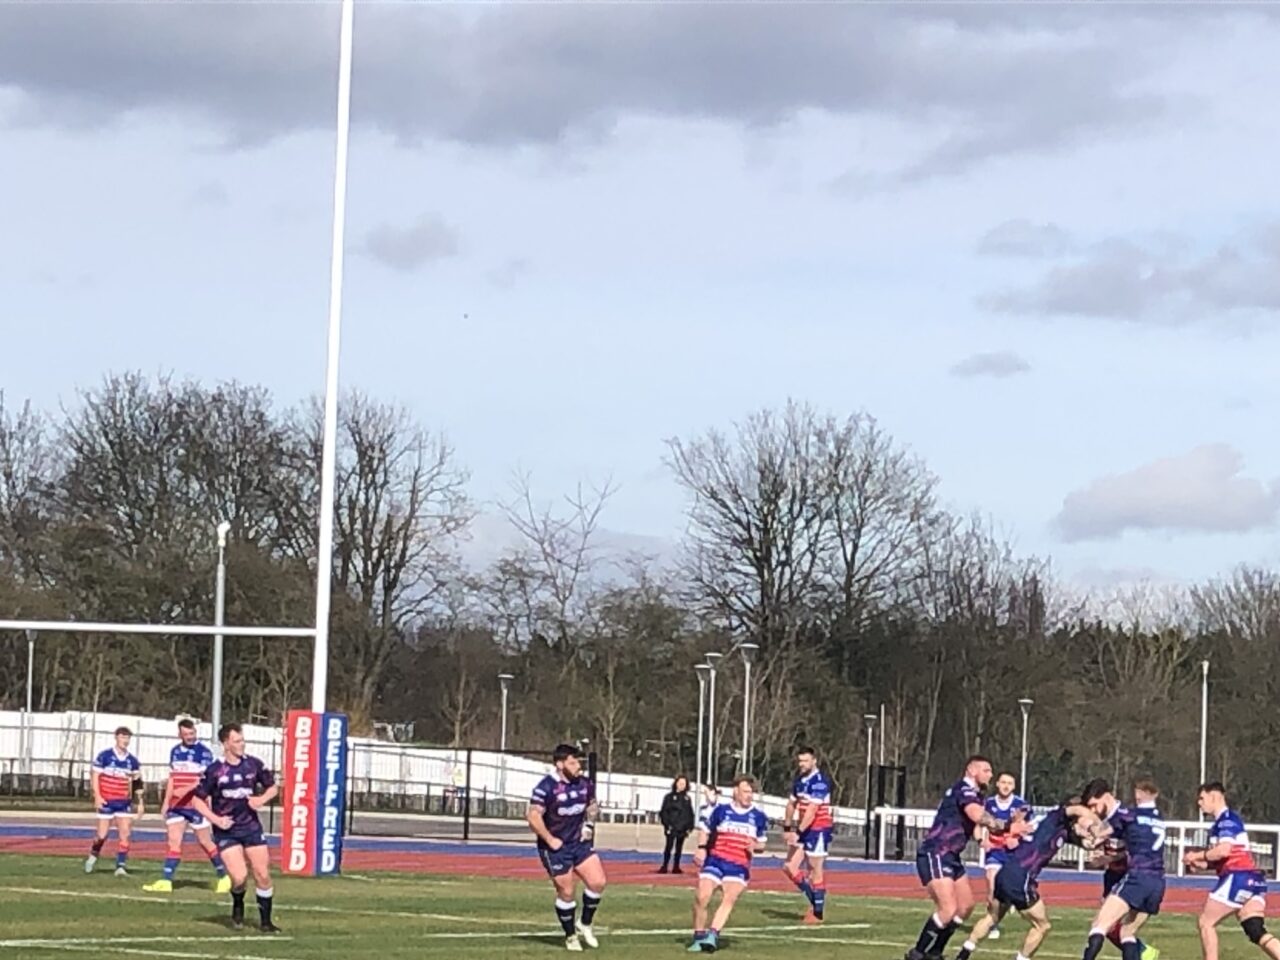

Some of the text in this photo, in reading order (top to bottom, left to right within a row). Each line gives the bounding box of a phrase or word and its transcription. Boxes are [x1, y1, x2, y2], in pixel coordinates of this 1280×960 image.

[289, 716, 312, 872] BETFRED
[321, 718, 342, 873] BETFRED
[1151, 826, 1165, 851] 7
